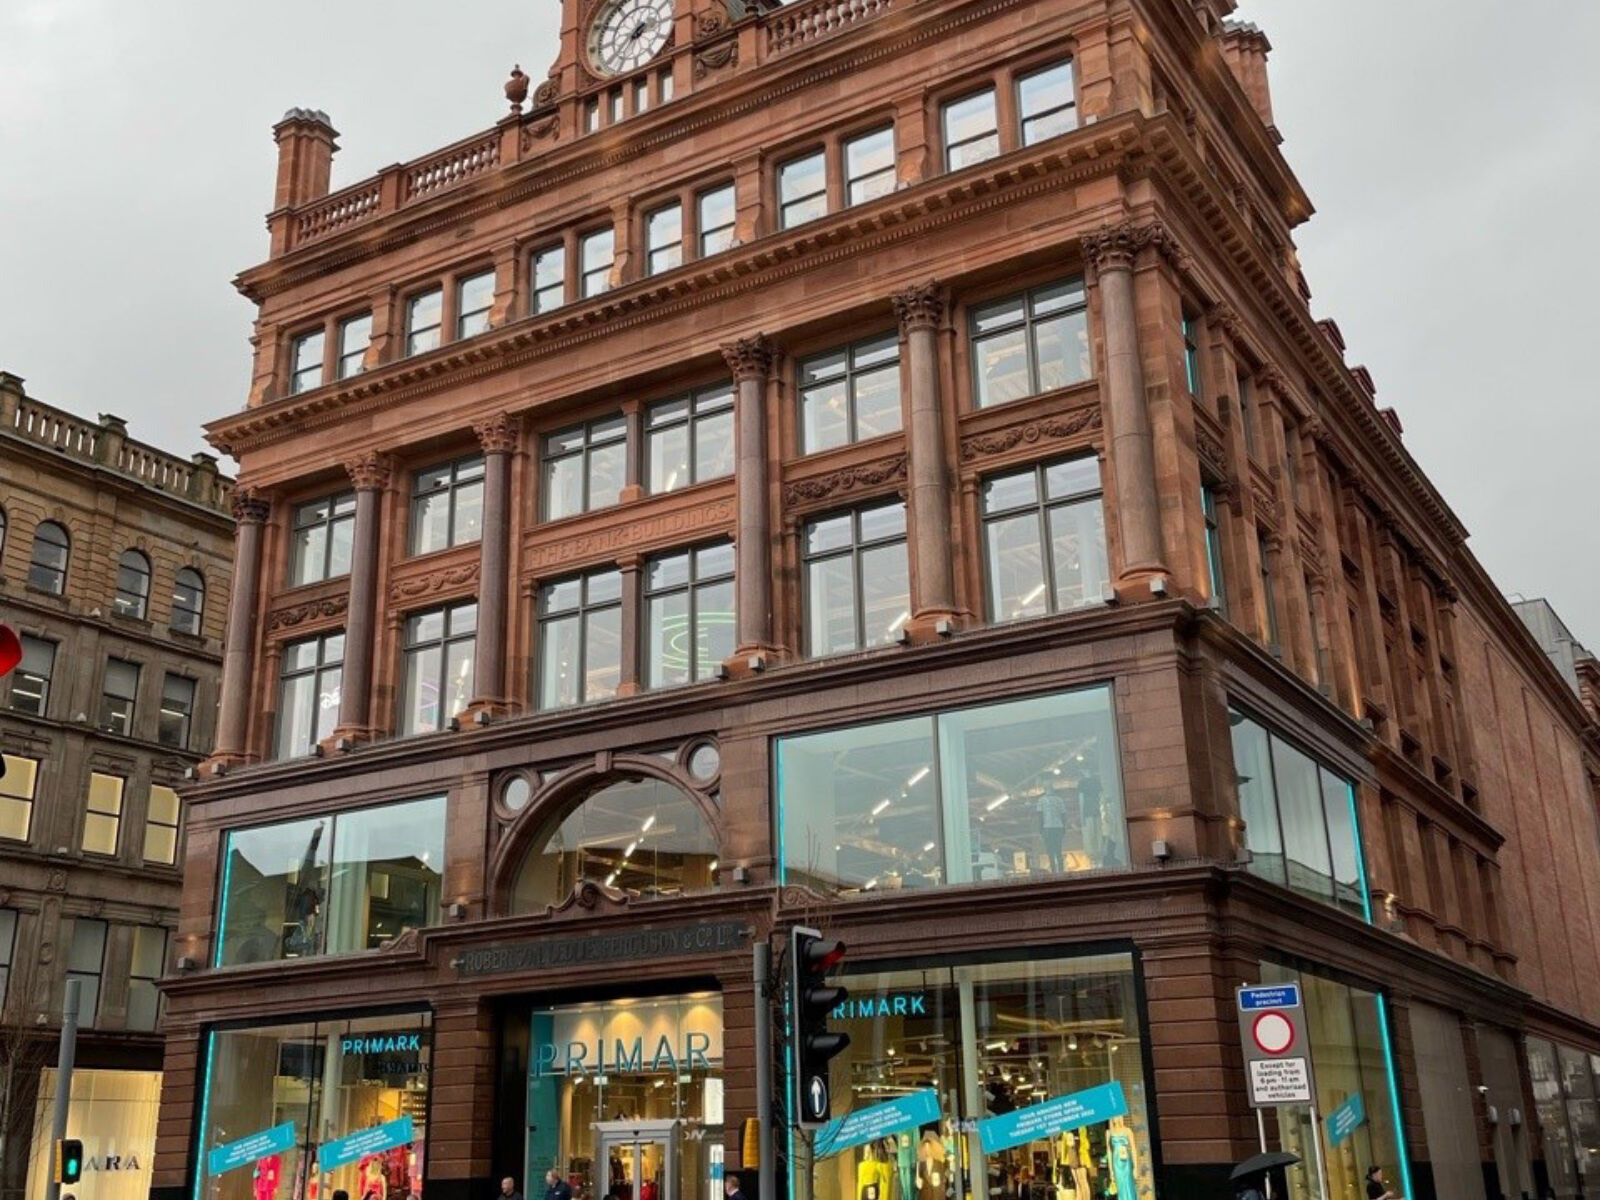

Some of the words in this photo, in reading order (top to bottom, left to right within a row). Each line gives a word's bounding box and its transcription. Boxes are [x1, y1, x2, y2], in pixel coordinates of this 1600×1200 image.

[1250, 989, 1286, 999] Pedestrian
[832, 995, 925, 1020] RIMARK
[1255, 998, 1282, 1007] precinct
[342, 1034, 420, 1056] PRIMARK
[534, 1031, 712, 1078] PRIMAR
[1260, 1062, 1284, 1070] Except
[1256, 1069, 1282, 1077] loading
[83, 1155, 141, 1171] ARA
